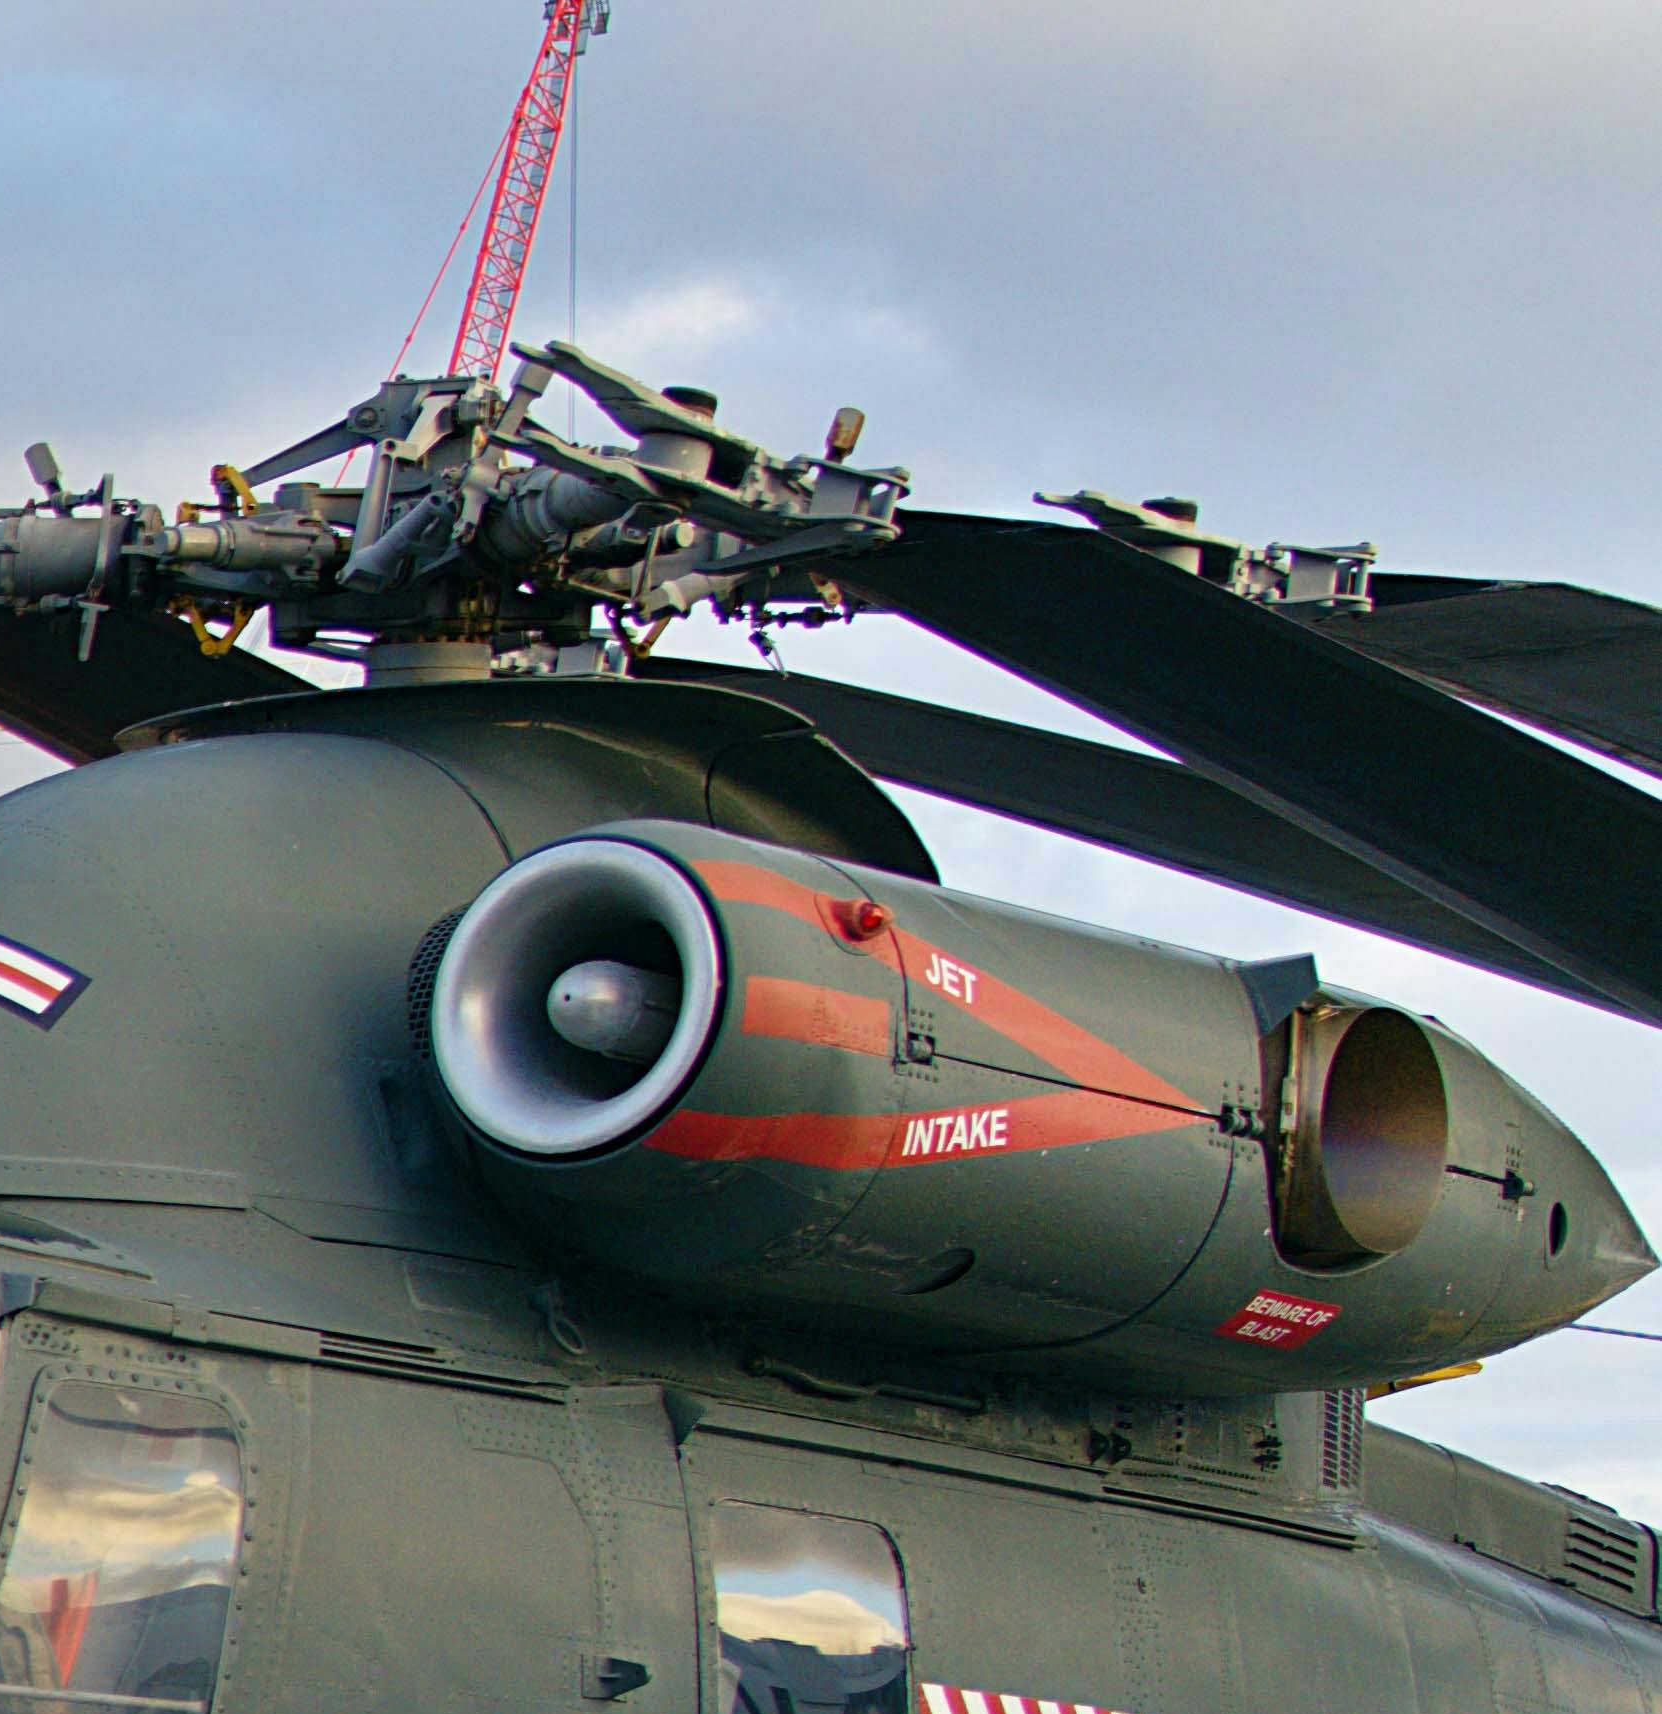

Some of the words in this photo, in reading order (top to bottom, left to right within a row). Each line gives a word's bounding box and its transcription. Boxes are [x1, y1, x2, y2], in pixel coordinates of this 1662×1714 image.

[925, 954, 978, 1004] JET
[901, 1109, 1008, 1156] INTAKE
[1236, 1321, 1291, 1342] BLAST
[1245, 1295, 1312, 1323] BEWARE
[1306, 1310, 1334, 1328] OF
